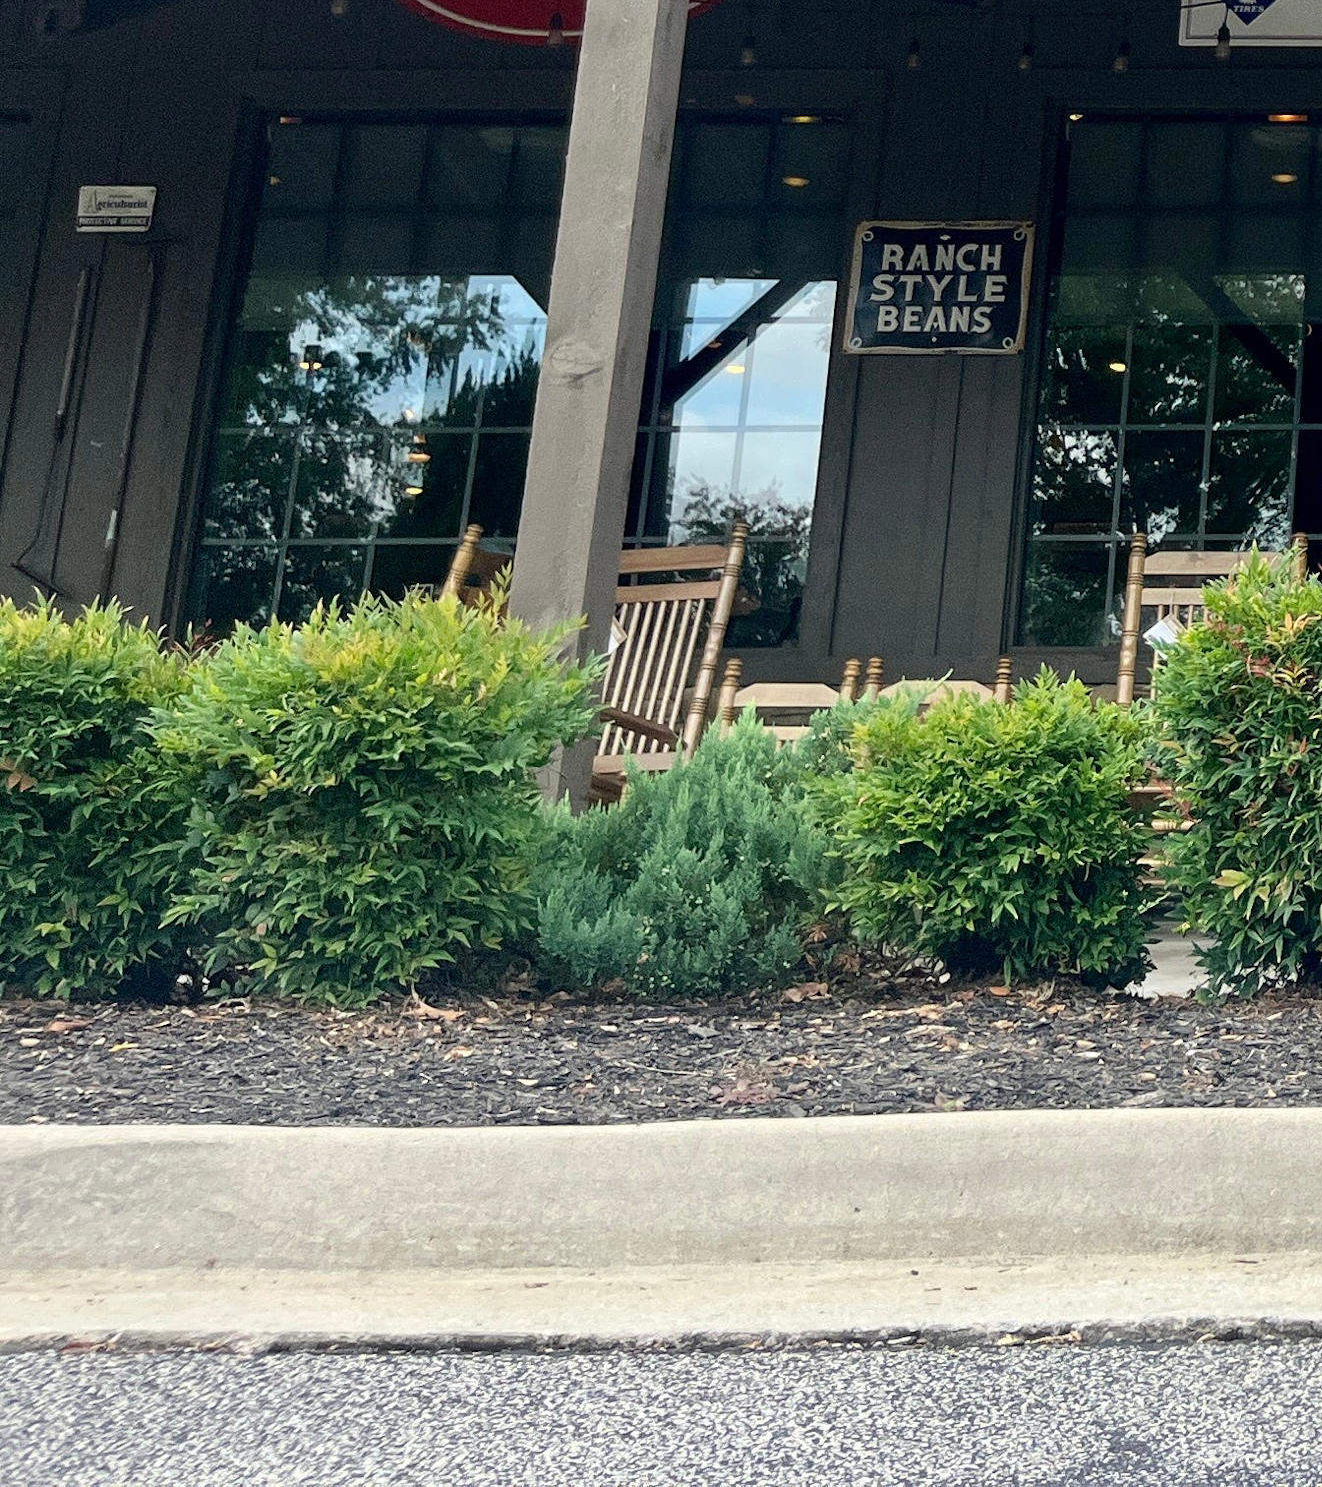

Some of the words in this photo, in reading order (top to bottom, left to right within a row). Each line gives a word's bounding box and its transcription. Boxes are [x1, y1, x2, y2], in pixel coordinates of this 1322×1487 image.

[1232, 4, 1265, 14] TIRES
[881, 243, 1002, 272] RANCH
[868, 273, 1009, 302] STYLE
[876, 305, 995, 334] BEANS
